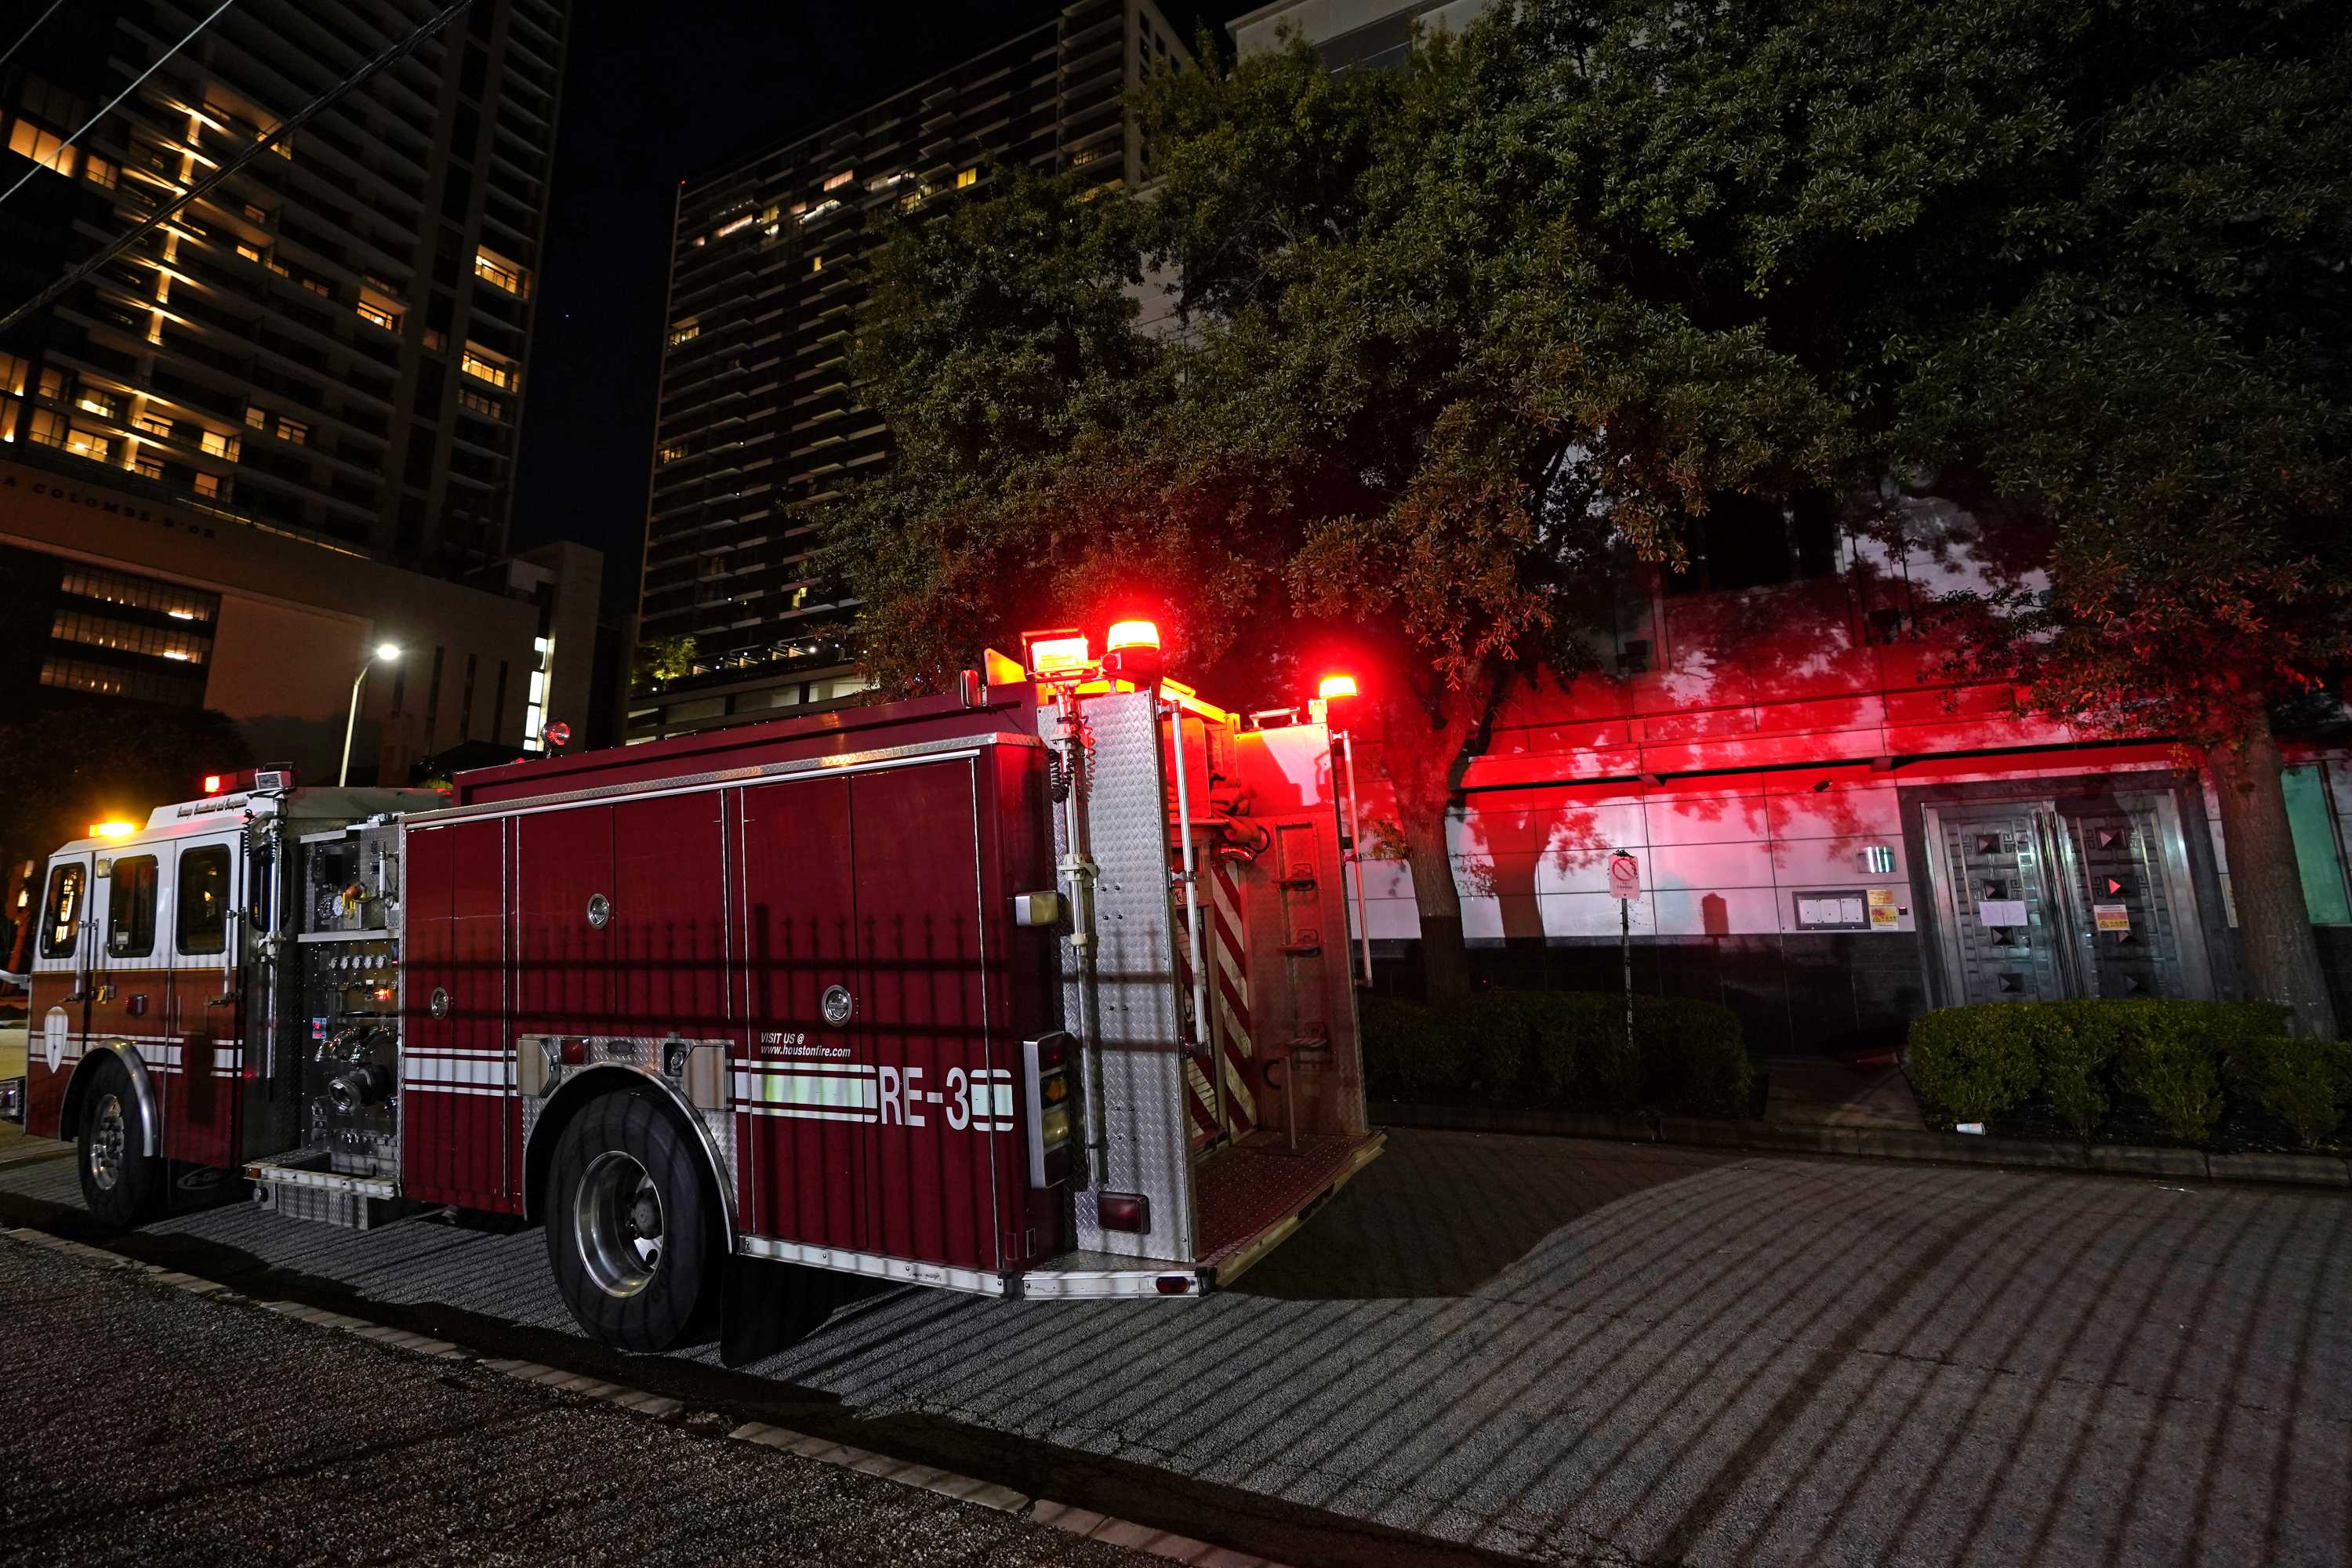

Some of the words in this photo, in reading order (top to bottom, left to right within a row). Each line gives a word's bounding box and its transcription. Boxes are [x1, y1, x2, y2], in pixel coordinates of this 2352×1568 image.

[761, 1032, 782, 1044] VISIT
[783, 1033, 795, 1044] US
[797, 1033, 804, 1044] @
[761, 1044, 851, 1057] www.houstonfire.com
[879, 1066, 970, 1130] RE-3
